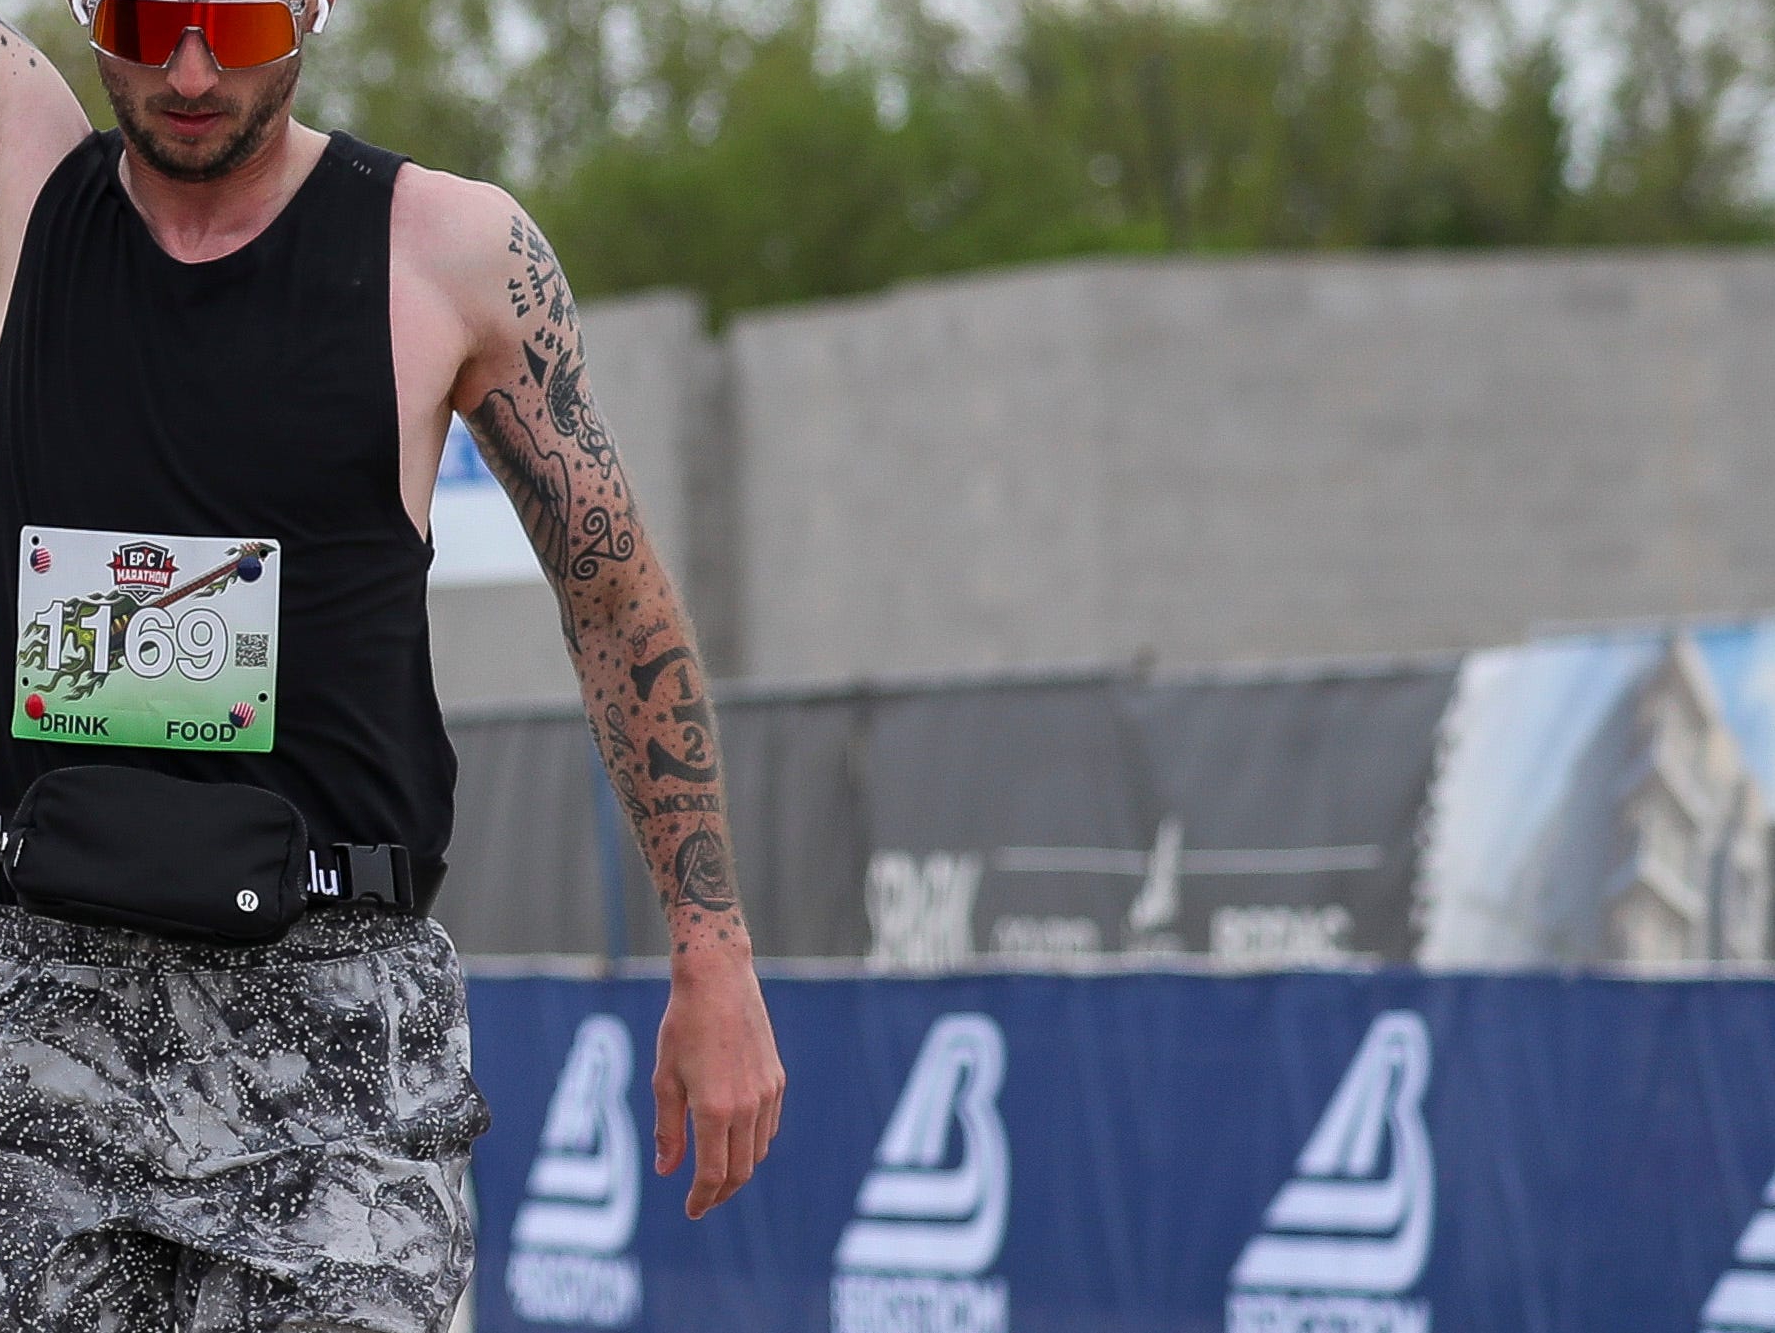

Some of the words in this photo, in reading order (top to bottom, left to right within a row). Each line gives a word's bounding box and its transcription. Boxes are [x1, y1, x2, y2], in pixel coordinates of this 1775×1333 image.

[116, 568, 169, 585] MARATHON
[34, 600, 227, 682] 1169
[38, 713, 110, 737] DRINK
[165, 720, 237, 743] FOOD
[306, 849, 340, 896] lu
